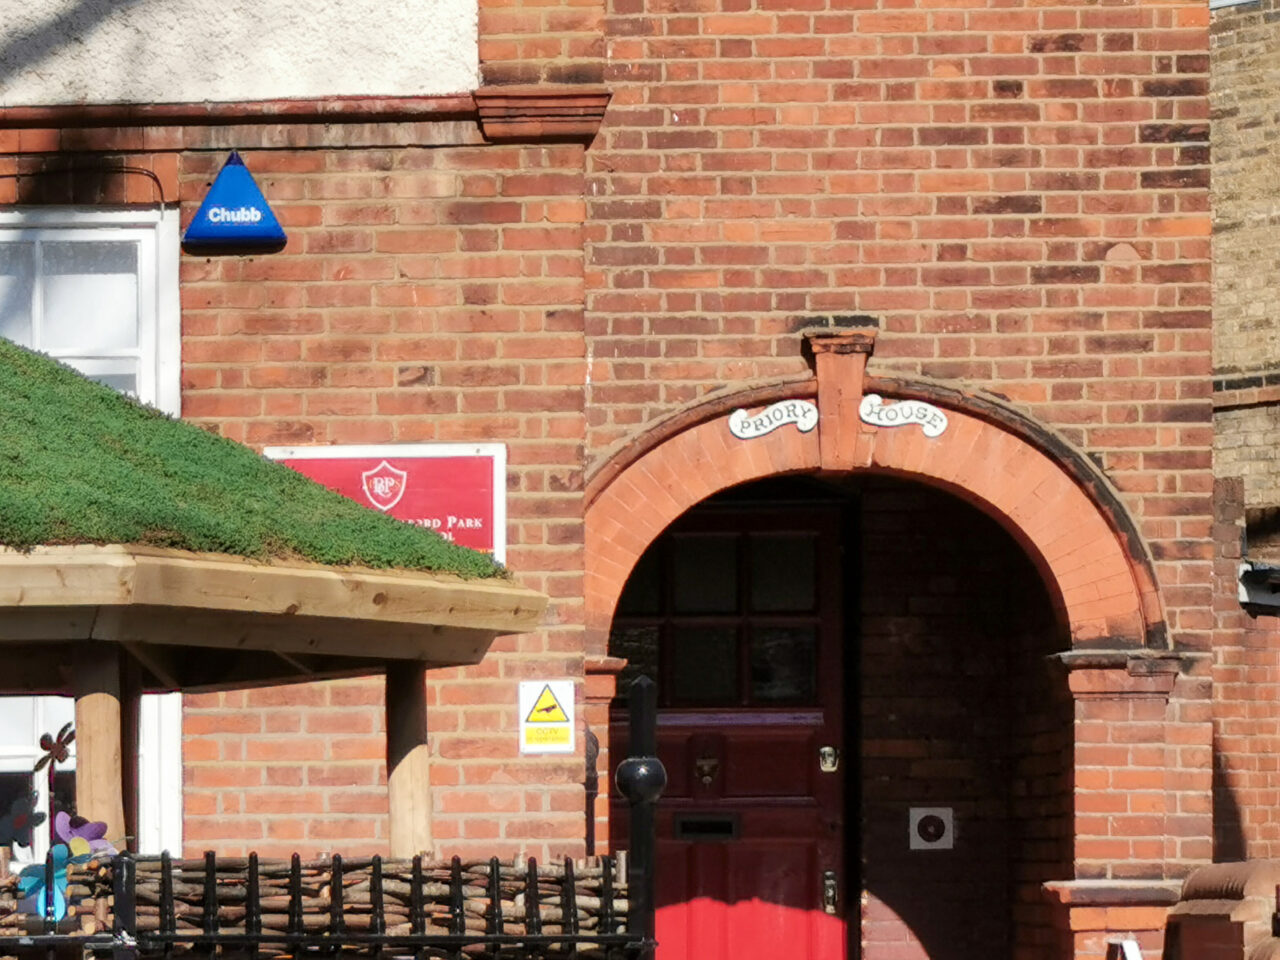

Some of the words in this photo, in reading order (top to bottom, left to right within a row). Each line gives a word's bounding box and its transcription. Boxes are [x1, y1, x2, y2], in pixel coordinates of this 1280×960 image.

[208, 206, 262, 222] Chubb
[740, 402, 812, 434] PRIORY
[867, 402, 945, 430] HOUSE
[447, 515, 483, 529] PARK
[535, 726, 560, 735] CCTV
